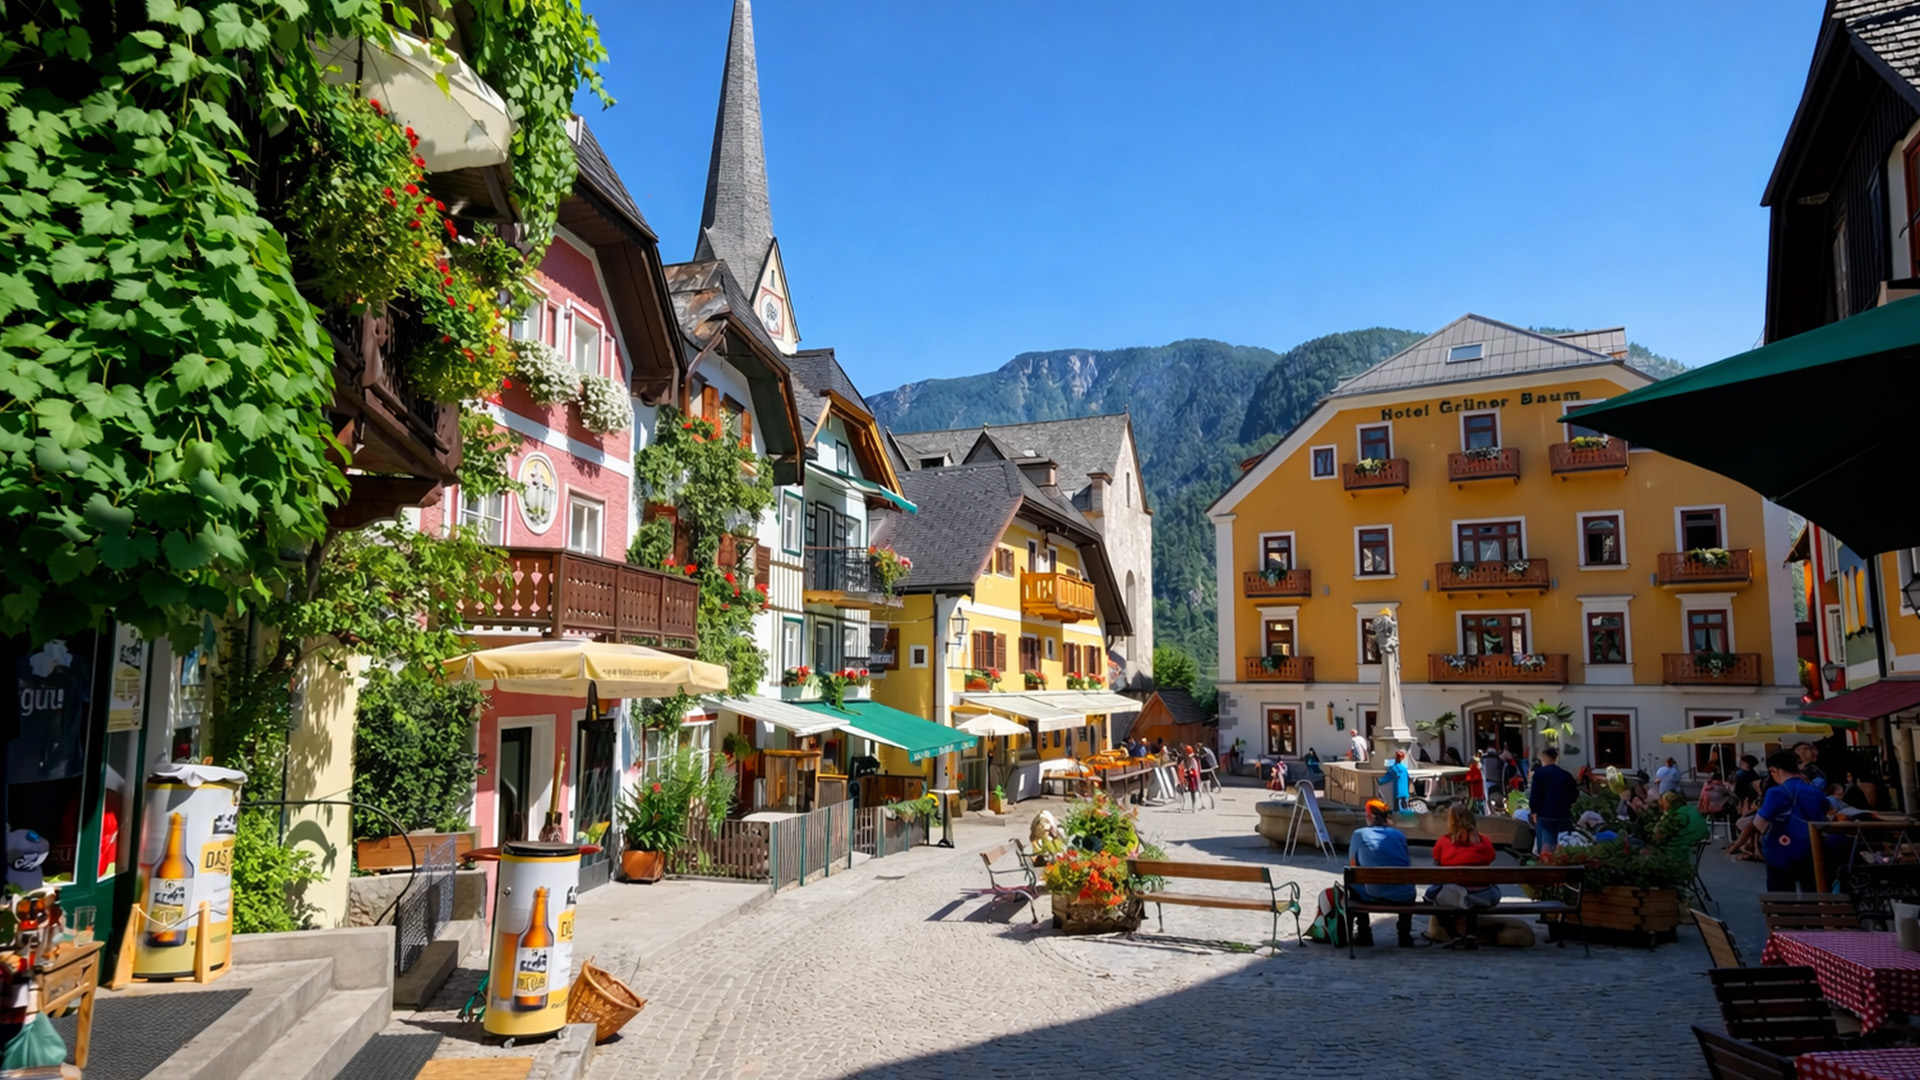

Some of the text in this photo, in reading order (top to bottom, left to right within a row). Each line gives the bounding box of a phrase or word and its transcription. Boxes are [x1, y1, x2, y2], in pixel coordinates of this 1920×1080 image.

[1381, 391, 1581, 421] Hotel Grüner Baum
